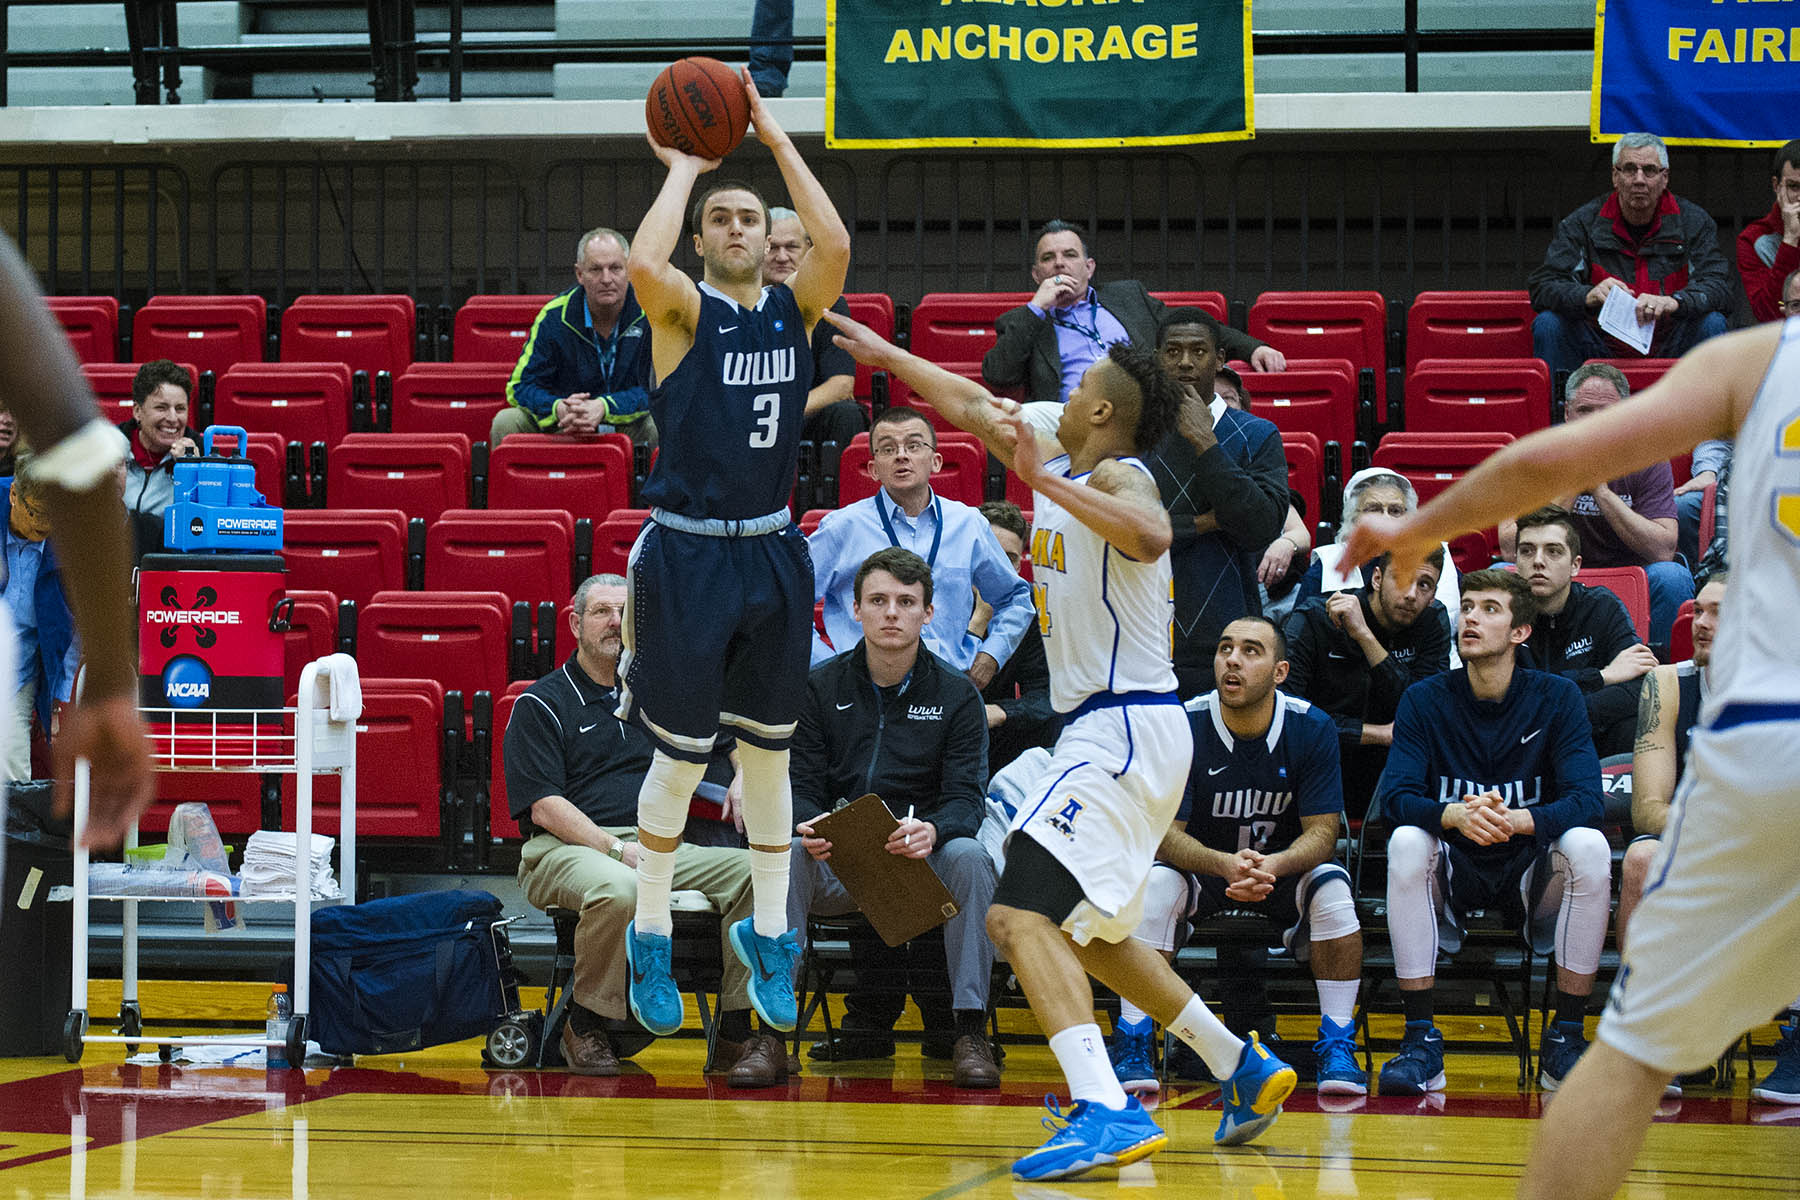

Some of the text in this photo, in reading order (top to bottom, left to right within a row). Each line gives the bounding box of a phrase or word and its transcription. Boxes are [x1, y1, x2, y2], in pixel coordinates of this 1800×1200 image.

[884, 23, 1199, 63] ANCHORAGE
[723, 346, 796, 386] WWU
[748, 393, 780, 448] 3
[217, 518, 277, 530] POWERADE
[146, 610, 241, 624] POWERADE
[166, 683, 210, 698] NCAA
[908, 704, 943, 715] WWU
[1212, 788, 1293, 819] WWU
